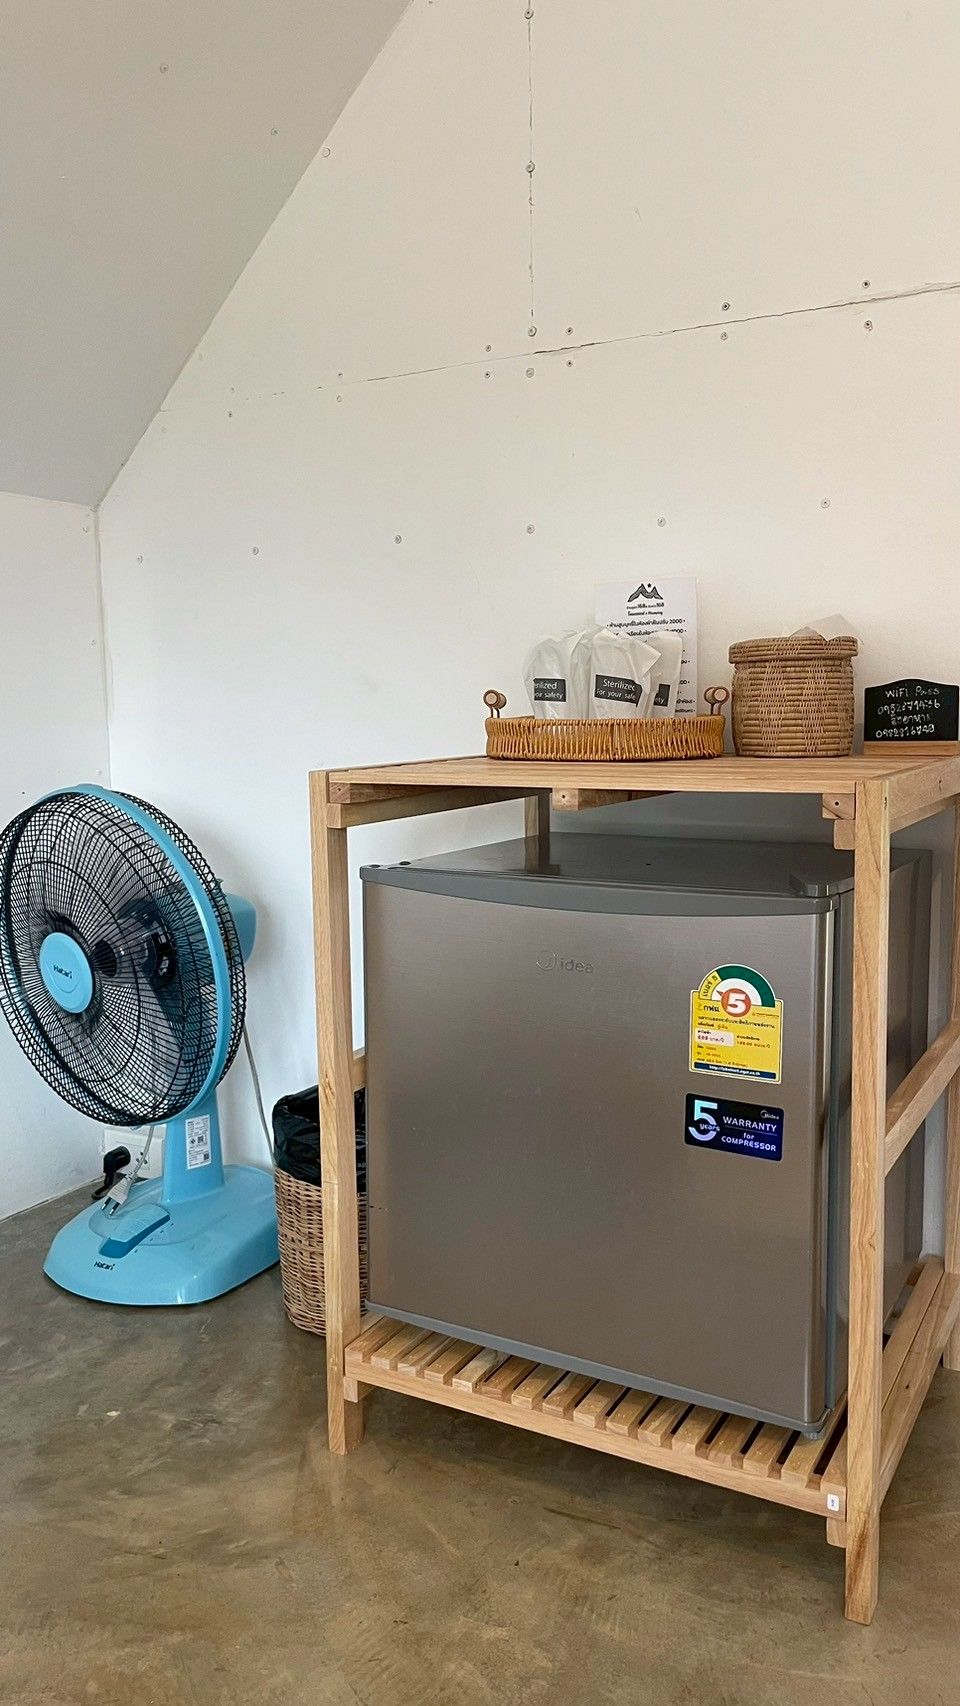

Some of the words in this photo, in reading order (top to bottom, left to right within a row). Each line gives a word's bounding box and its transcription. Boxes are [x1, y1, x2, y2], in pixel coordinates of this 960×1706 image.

[607, 690, 622, 698] your
[53, 964, 73, 979] Hatari
[725, 992, 747, 1015] 5
[688, 1099, 718, 1141] 5
[699, 1122, 721, 1132] years
[722, 1116, 777, 1132] WARRANTY
[720, 1135, 777, 1152] COMPRESSOR
[743, 1132, 754, 1140] for
[93, 1261, 116, 1271] Hatari
